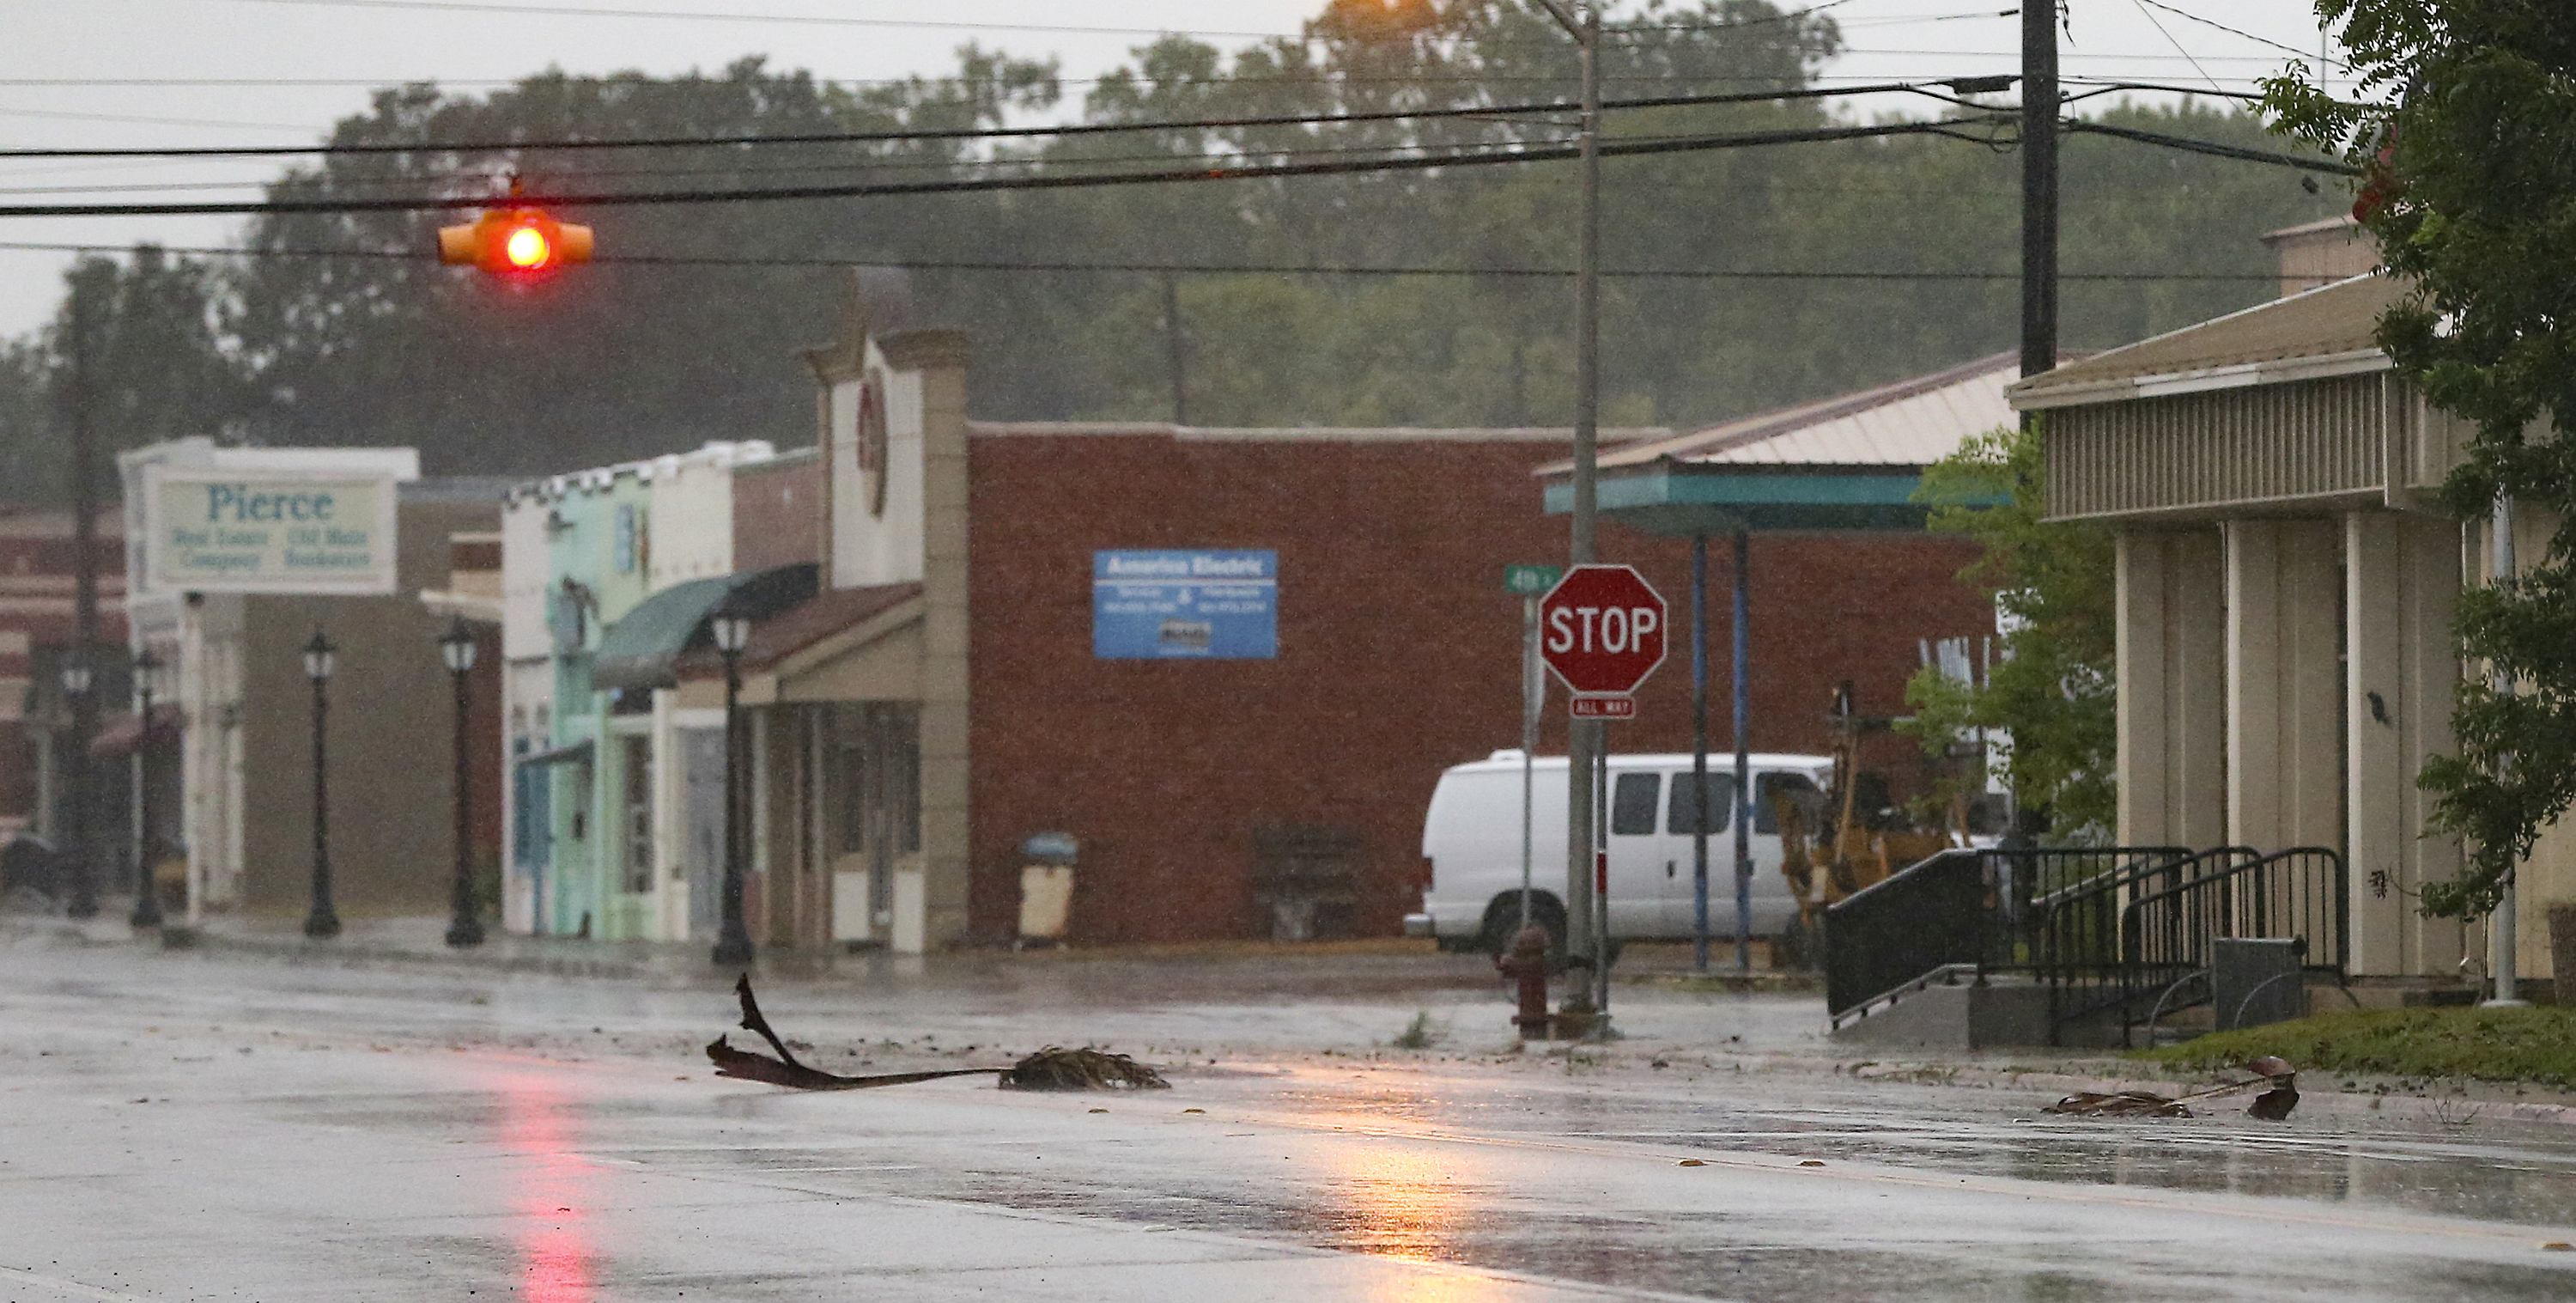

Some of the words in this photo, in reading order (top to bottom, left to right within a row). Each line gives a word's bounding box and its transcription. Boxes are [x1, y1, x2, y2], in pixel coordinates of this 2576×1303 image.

[208, 484, 333, 521] Pierce
[173, 528, 209, 546] Real
[216, 528, 268, 547] Estate
[179, 549, 261, 571] Company
[1192, 554, 1262, 576] Electric
[1548, 606, 1658, 655] STOP
[1577, 700, 1597, 715] ALL
[1604, 700, 1630, 715] WAY
